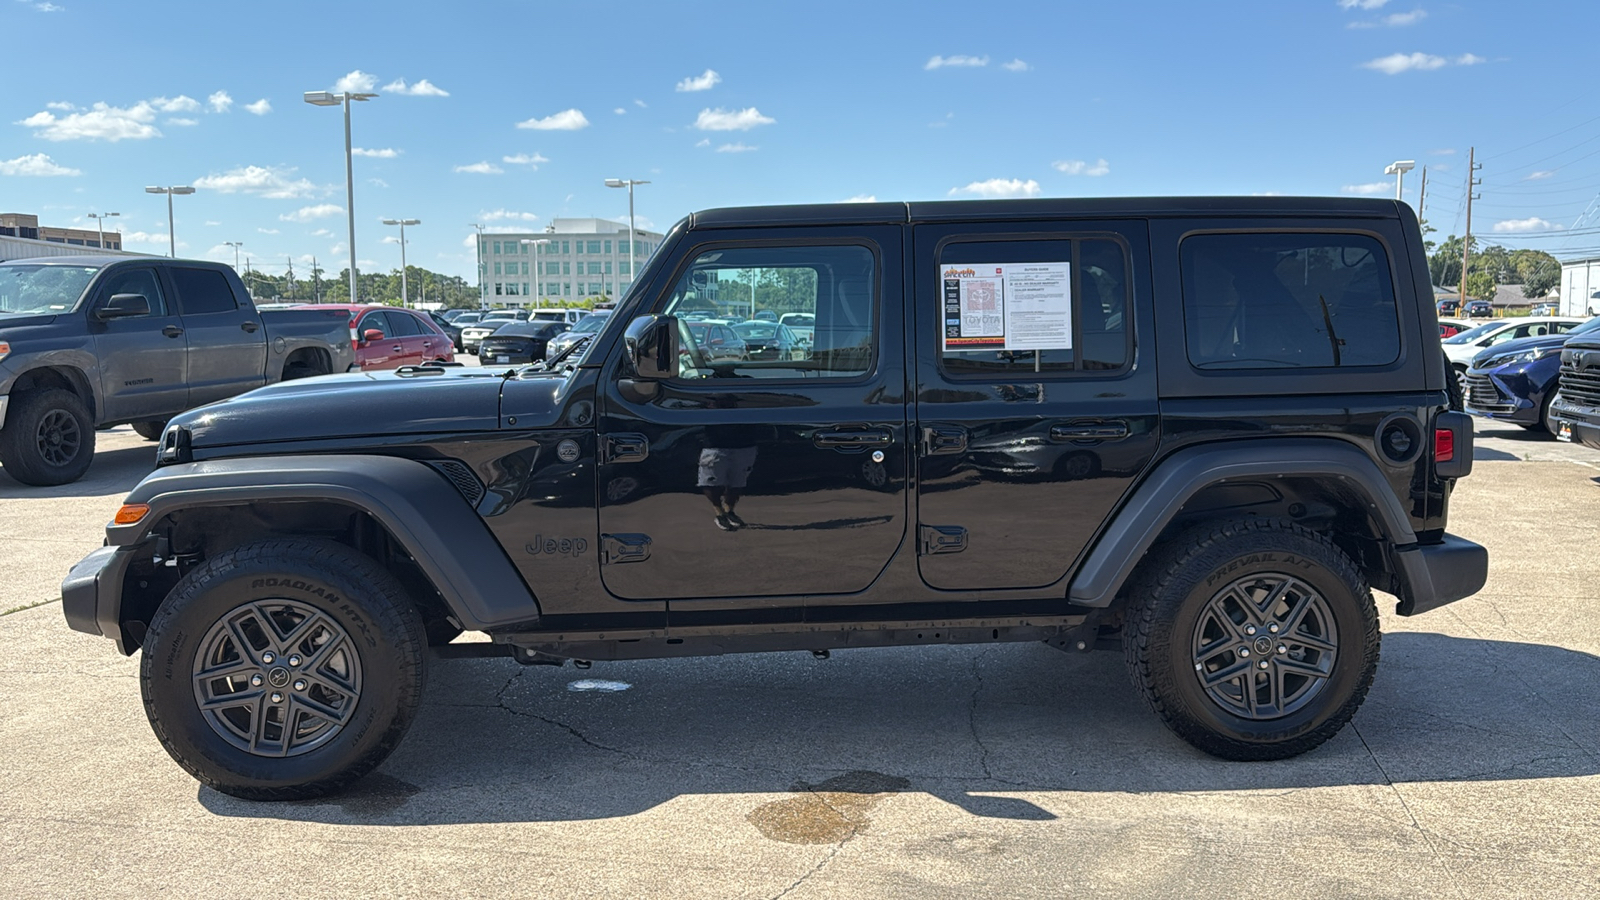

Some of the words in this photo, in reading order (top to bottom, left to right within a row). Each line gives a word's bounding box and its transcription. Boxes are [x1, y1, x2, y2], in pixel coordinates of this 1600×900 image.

[964, 315, 1001, 324] TOYOTA
[526, 534, 588, 557] Jeep
[1206, 553, 1277, 587] PREVAIL
[1283, 555, 1317, 569] A/T
[251, 578, 340, 604] ROADIAN
[340, 604, 377, 647] HTX2
